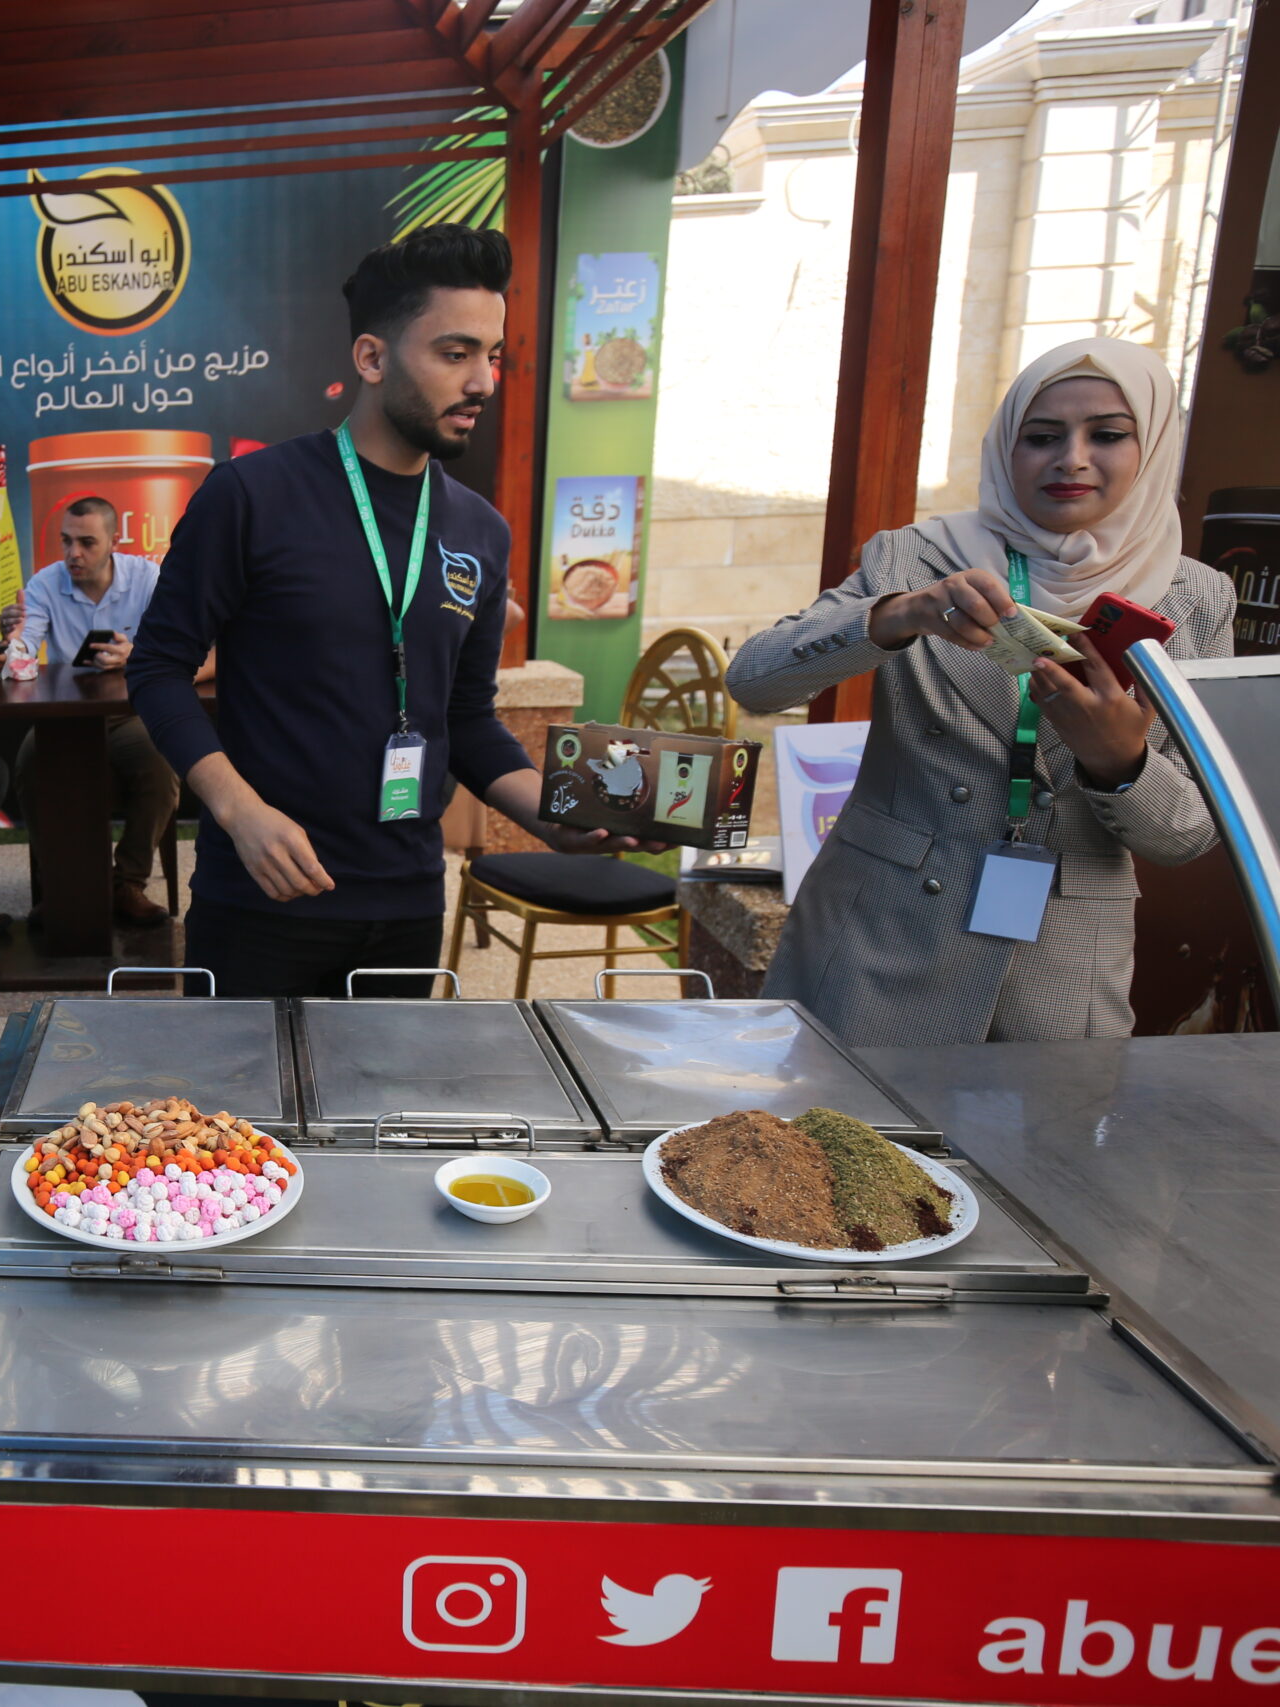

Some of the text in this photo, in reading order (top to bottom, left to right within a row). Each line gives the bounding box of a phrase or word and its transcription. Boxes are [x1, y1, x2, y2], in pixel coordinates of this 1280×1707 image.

[56, 270, 173, 294] ABU ESKANDAR
[588, 278, 647, 305] زعتر
[10, 342, 75, 389] أنواع
[81, 340, 147, 382] أفخر
[154, 349, 196, 378] من
[204, 345, 269, 381] مزيج
[35, 384, 193, 417] حول العالم
[570, 494, 621, 521] دقة
